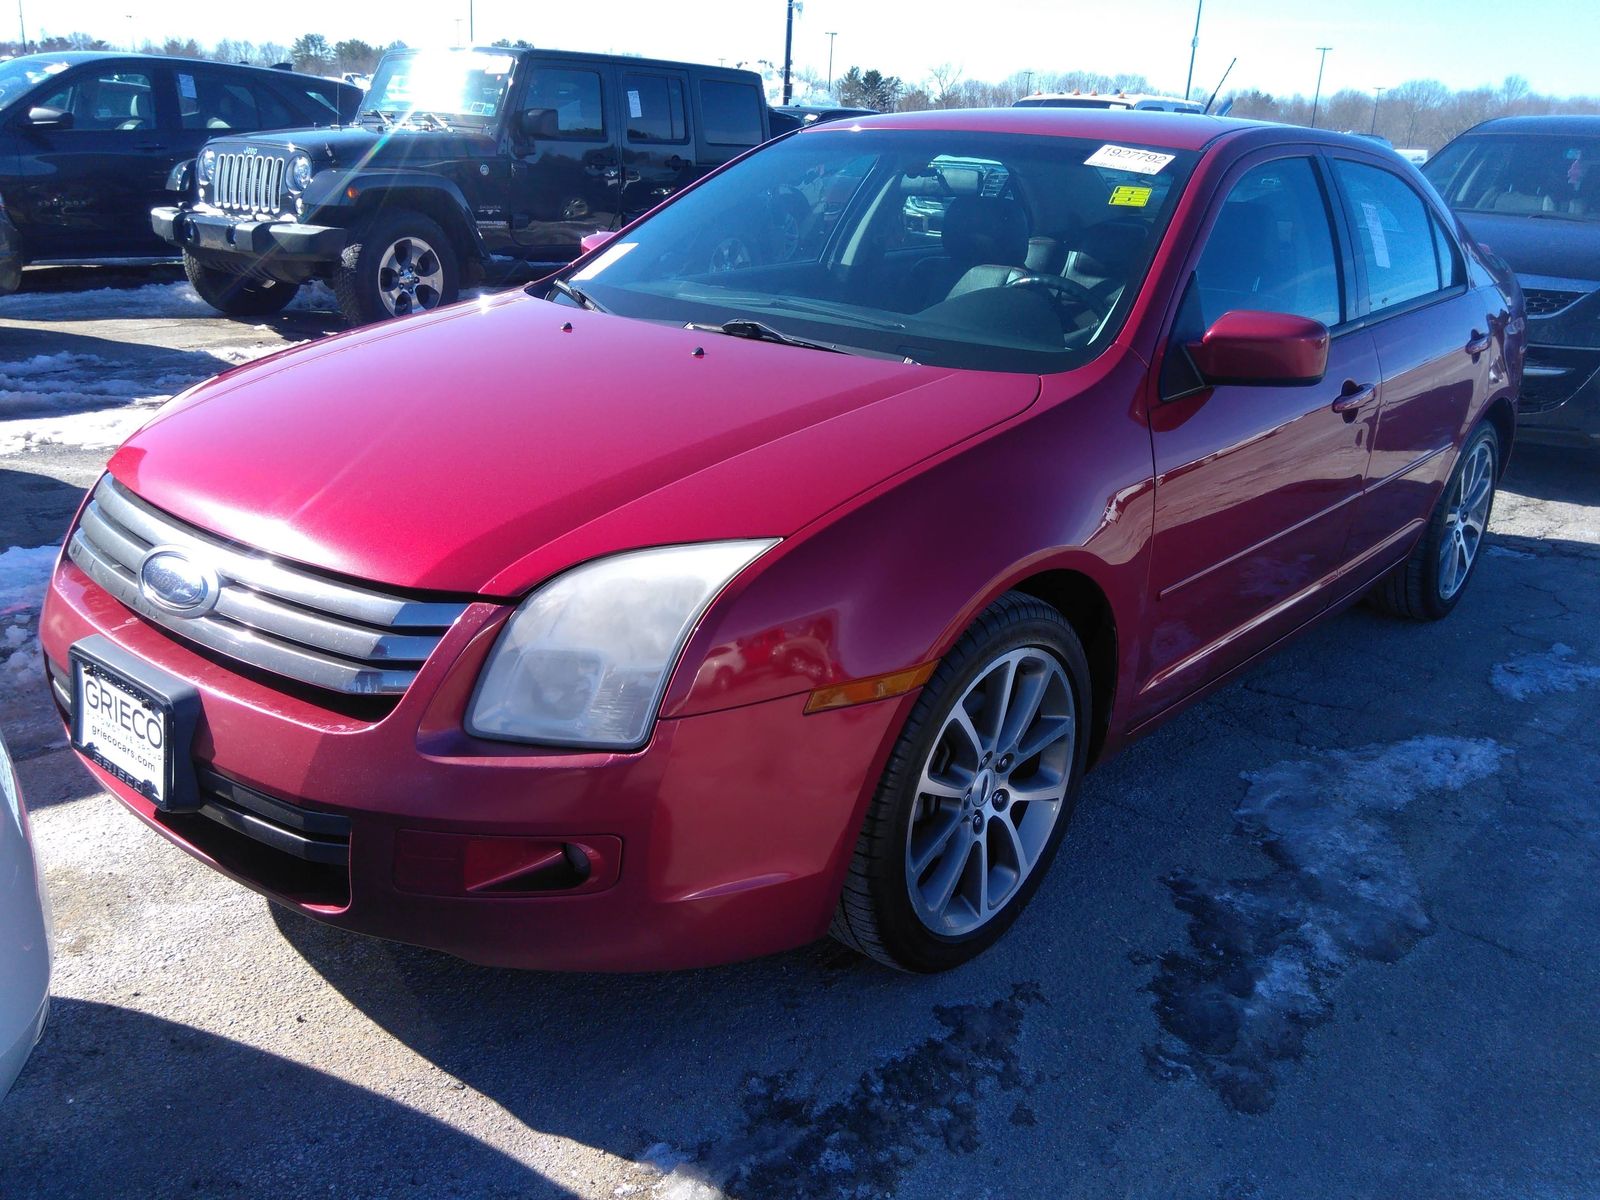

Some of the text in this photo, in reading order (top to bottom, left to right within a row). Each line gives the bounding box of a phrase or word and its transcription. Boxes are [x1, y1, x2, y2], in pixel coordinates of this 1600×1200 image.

[1103, 147, 1167, 164] 1927792
[85, 680, 164, 750] GRIECO
[91, 725, 156, 773] griecocars.com
